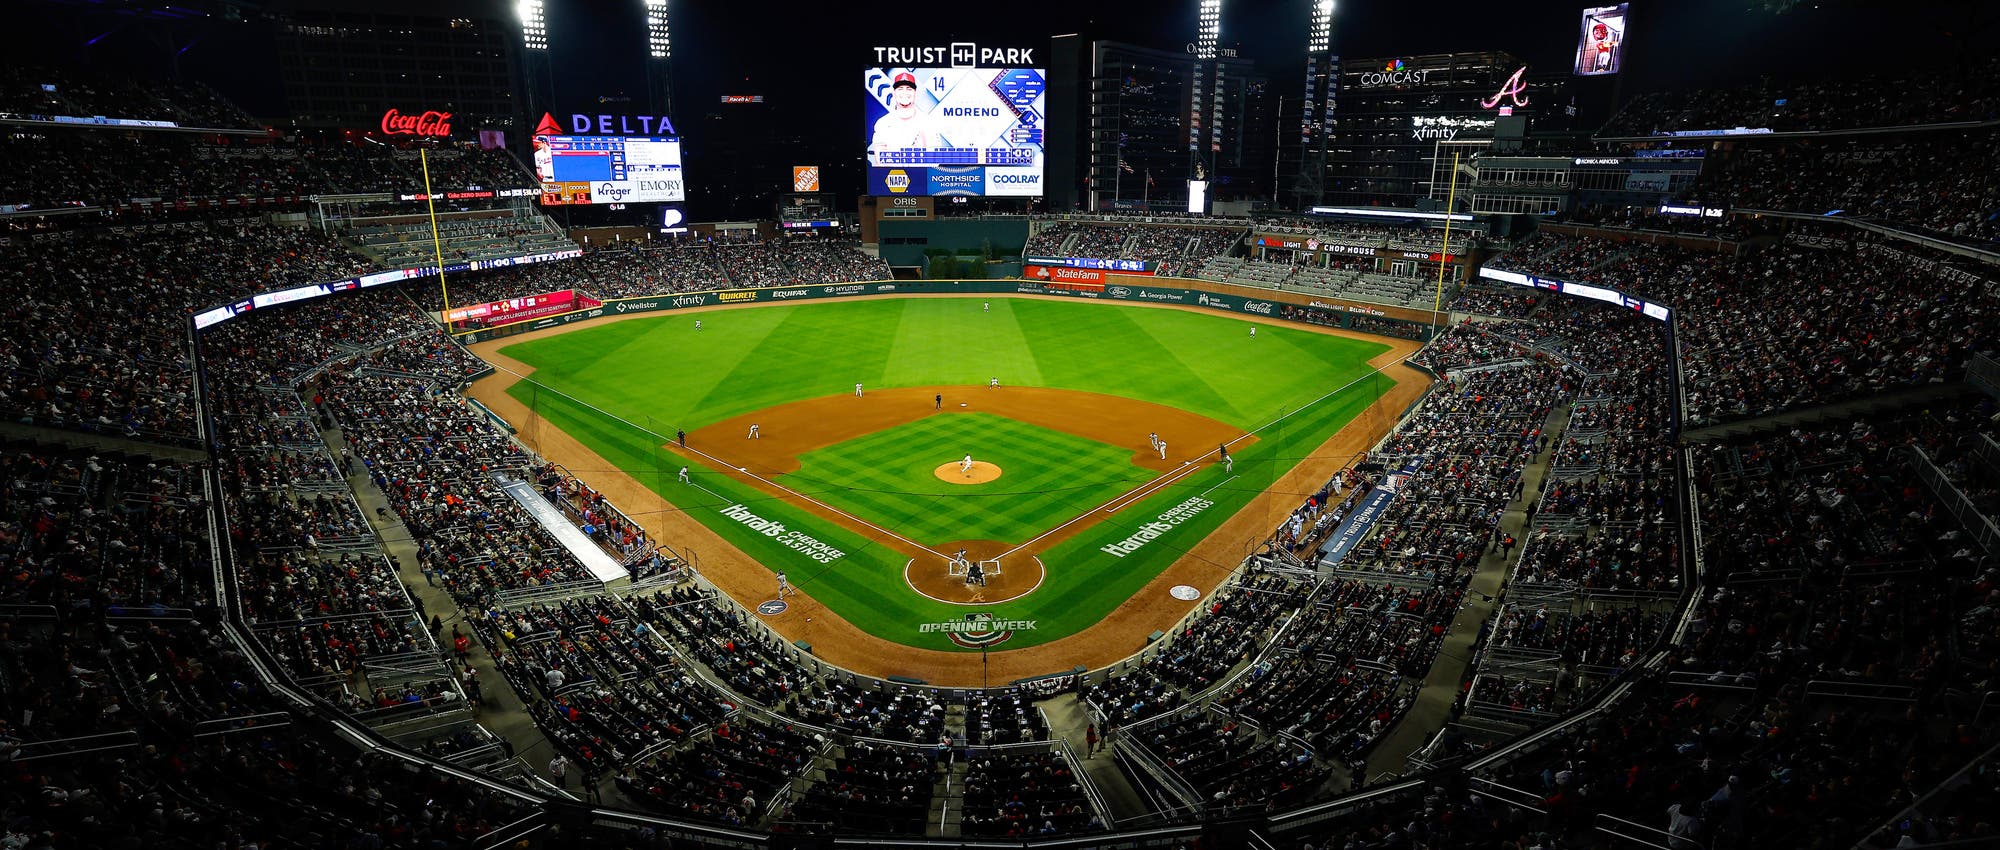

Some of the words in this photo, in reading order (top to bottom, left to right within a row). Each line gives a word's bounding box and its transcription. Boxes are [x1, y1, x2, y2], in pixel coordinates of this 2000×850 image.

[874, 47, 946, 64] TRUIST
[981, 48, 1034, 65] PARK
[933, 76, 945, 92] 14
[1360, 71, 1429, 85] COMCAST
[943, 107, 999, 117] MORENO
[382, 108, 451, 137] Coca-Cola
[572, 114, 675, 134] DELTA
[1412, 125, 1458, 142] xfinity
[640, 180, 681, 191] EMORY
[888, 176, 907, 187] NAPA
[993, 174, 1040, 184] COOLRAY
[598, 182, 632, 202] Kroger
[894, 198, 917, 206] ORIS
[1284, 240, 1302, 248] LIGHT
[1324, 244, 1346, 254] CHOP
[1348, 246, 1375, 256] HOUSE
[719, 291, 757, 300] QUIKRETE
[773, 290, 808, 298] EQUIFAX
[1148, 292, 1166, 300] Georgia
[628, 302, 658, 310] Wellstar
[672, 294, 706, 308] xfinity
[1169, 500, 1214, 525] CASINOS
[776, 534, 834, 564] CASINOS
[788, 530, 848, 560] CHEROKEE
[920, 621, 988, 633] OPENING
[992, 620, 1037, 631] WEEK
